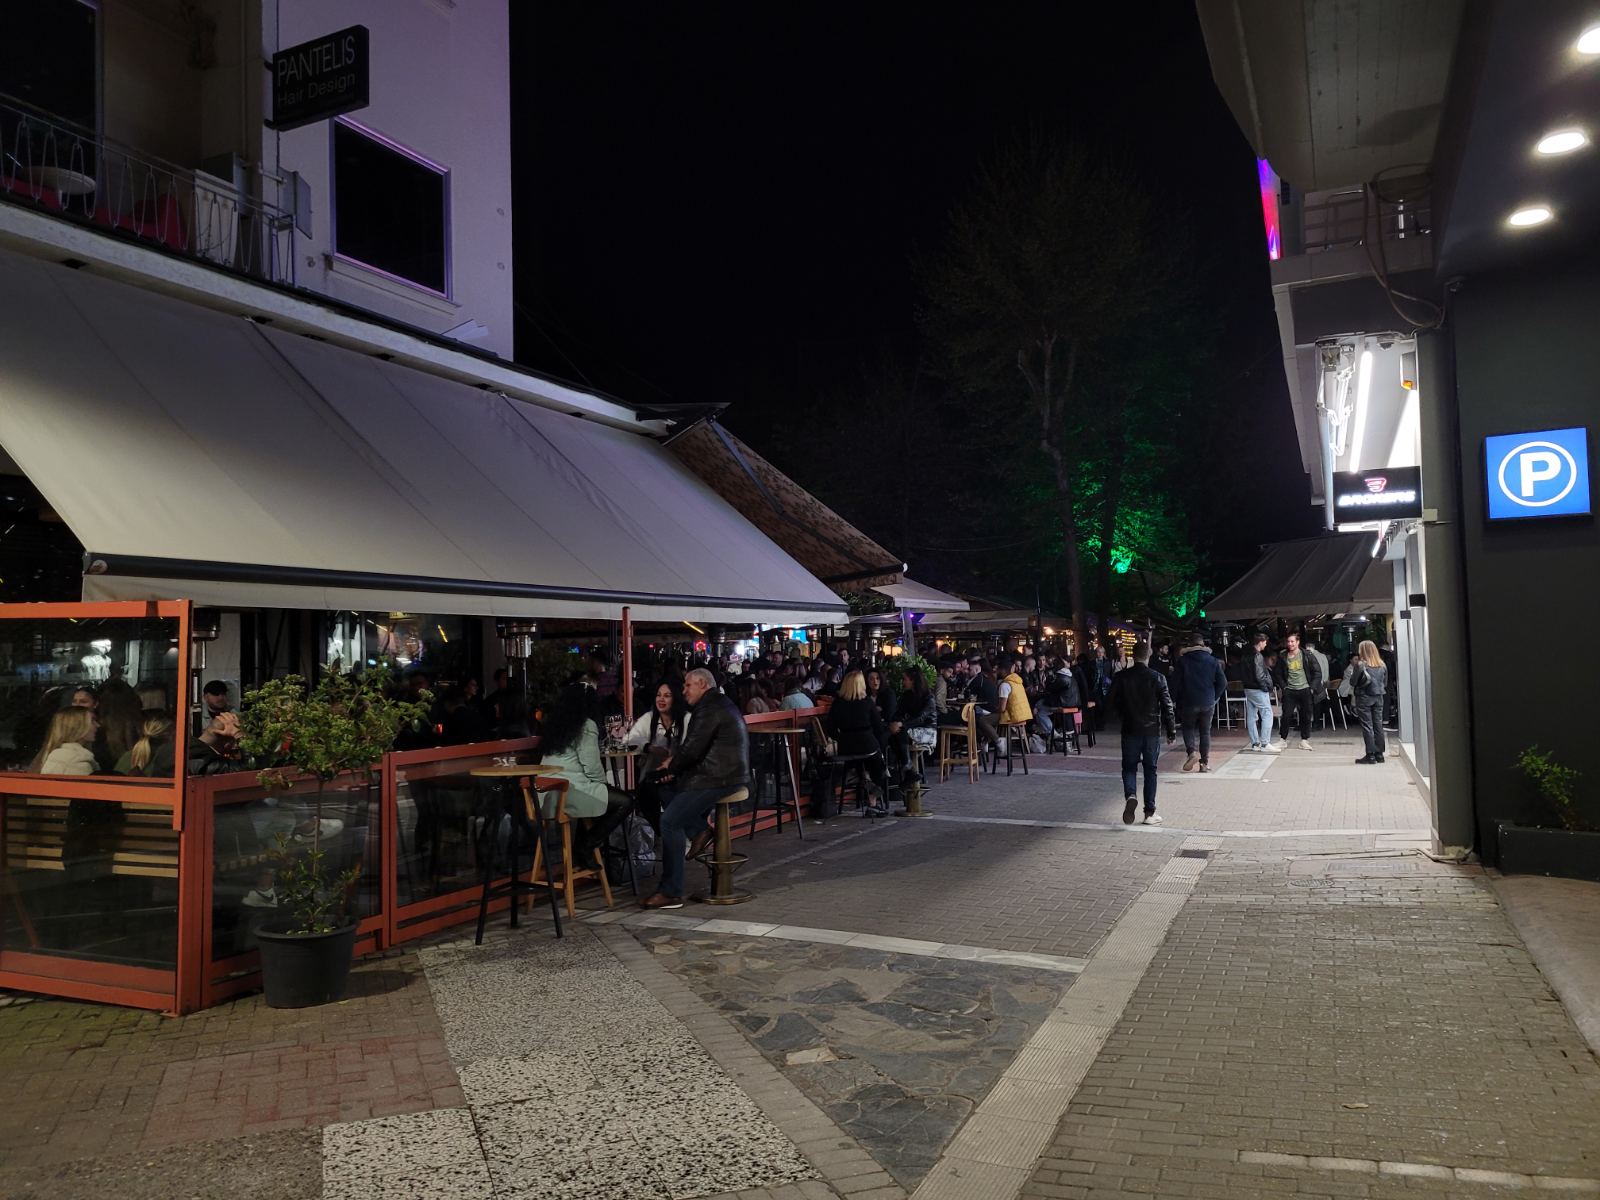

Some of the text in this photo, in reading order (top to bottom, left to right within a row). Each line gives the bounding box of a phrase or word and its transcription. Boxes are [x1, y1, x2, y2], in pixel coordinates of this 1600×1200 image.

[278, 35, 356, 87] PANTELIS
[278, 72, 356, 107] Hair Design
[1519, 451, 1562, 497] P
